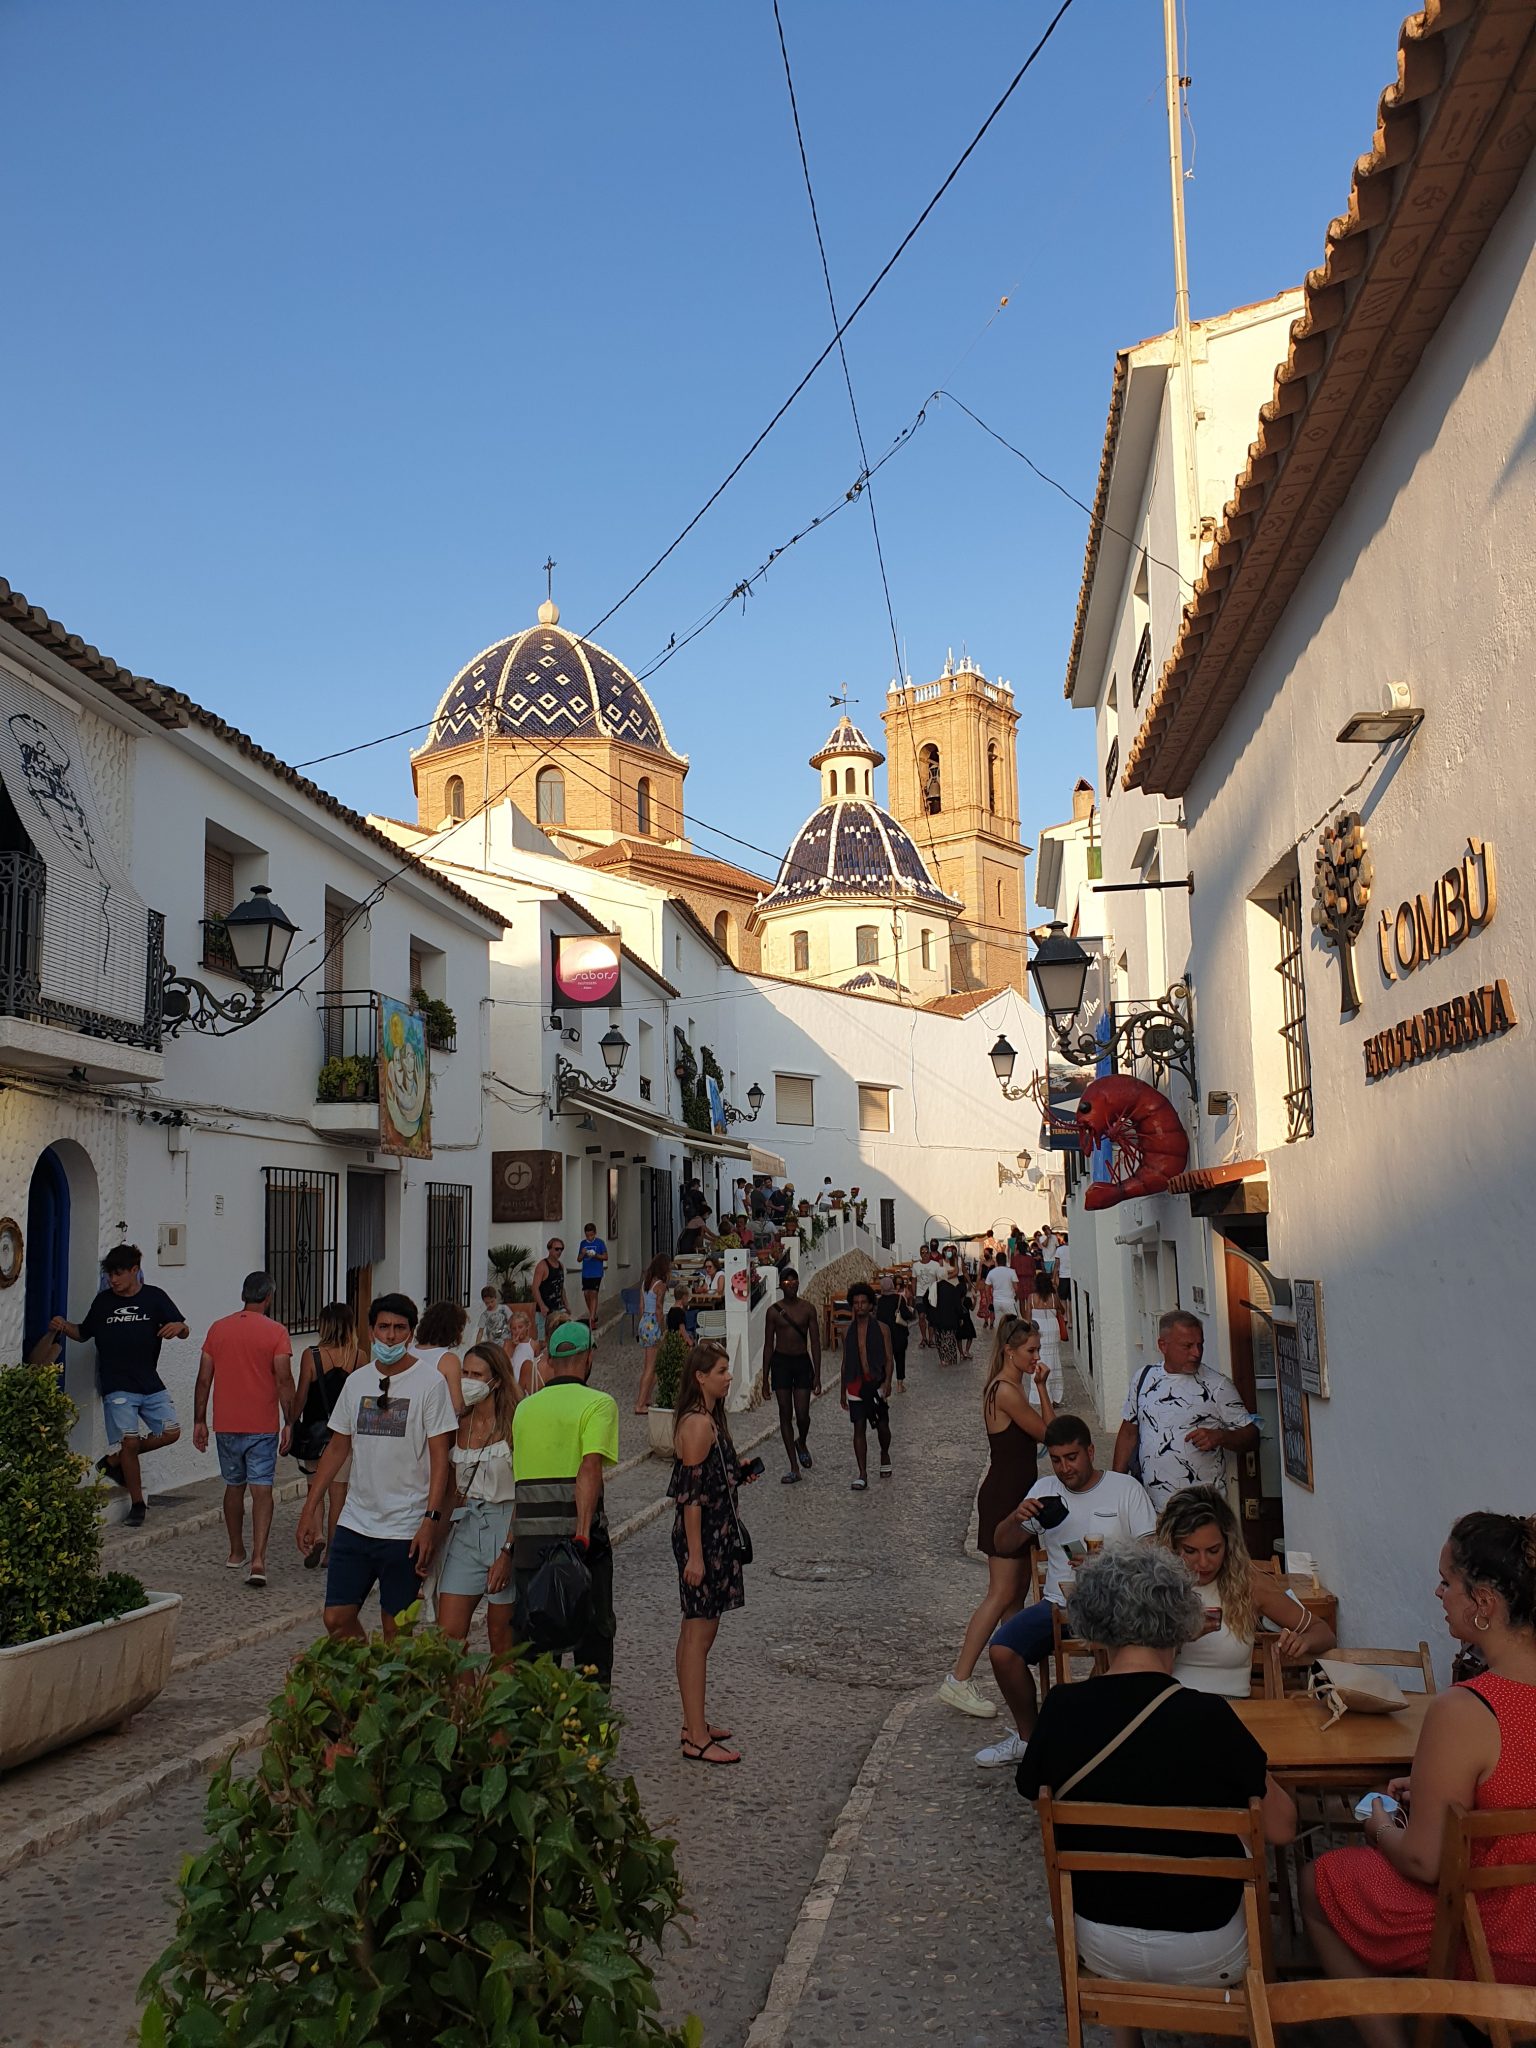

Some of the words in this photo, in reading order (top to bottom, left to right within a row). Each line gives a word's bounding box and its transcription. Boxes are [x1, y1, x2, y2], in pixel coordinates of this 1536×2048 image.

[572, 969, 617, 981] sabors
[1363, 978, 1518, 1078] ENOTABERNA
[106, 1313, 151, 1324] O'NEILL
